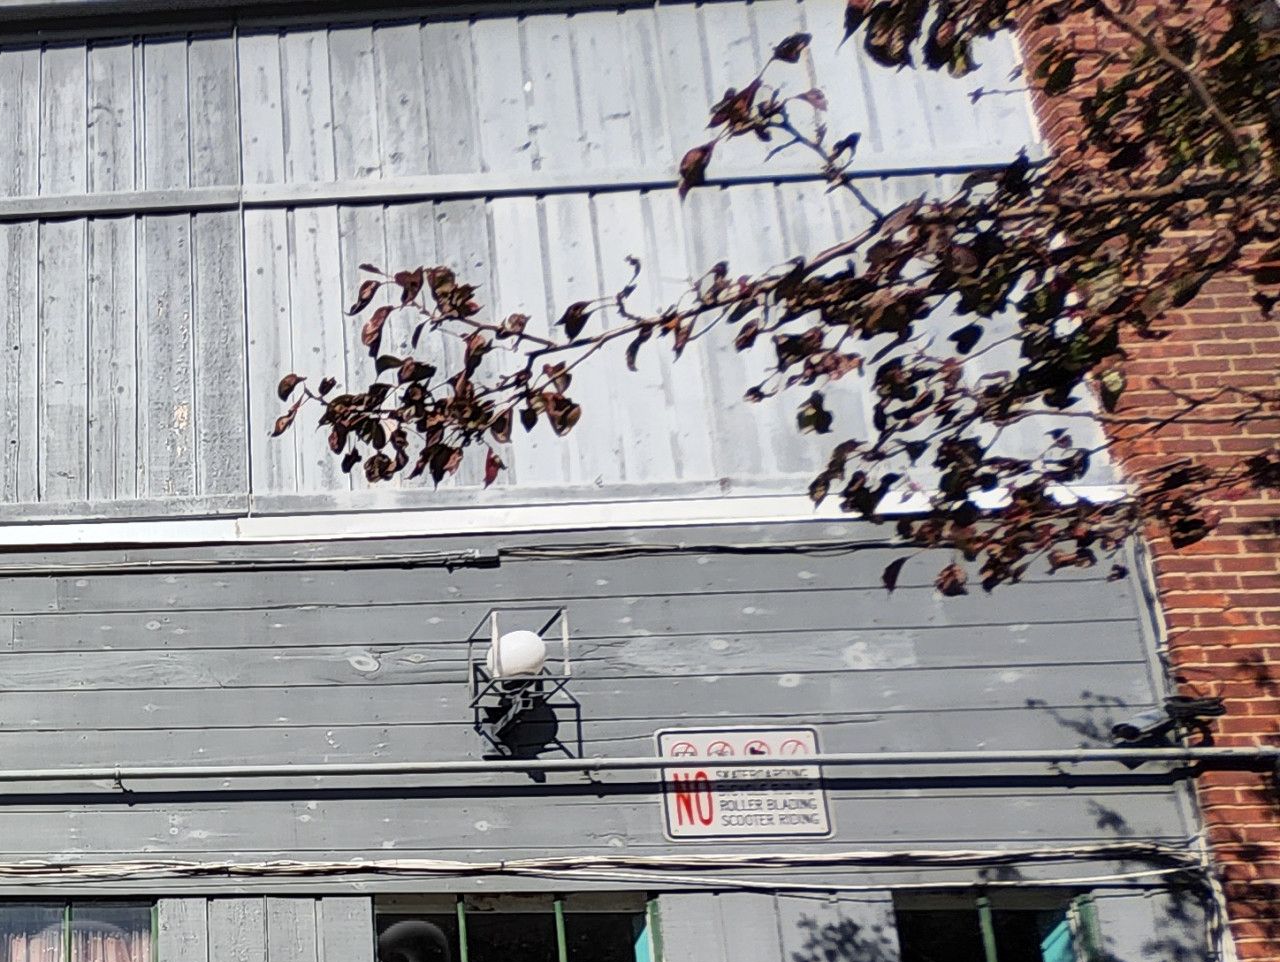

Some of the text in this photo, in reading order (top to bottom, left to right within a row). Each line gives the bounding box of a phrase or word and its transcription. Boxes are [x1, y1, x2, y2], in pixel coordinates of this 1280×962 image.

[674, 771, 713, 826] NO
[720, 799, 763, 812] ROLLER
[721, 814, 776, 826] SCOOTER
